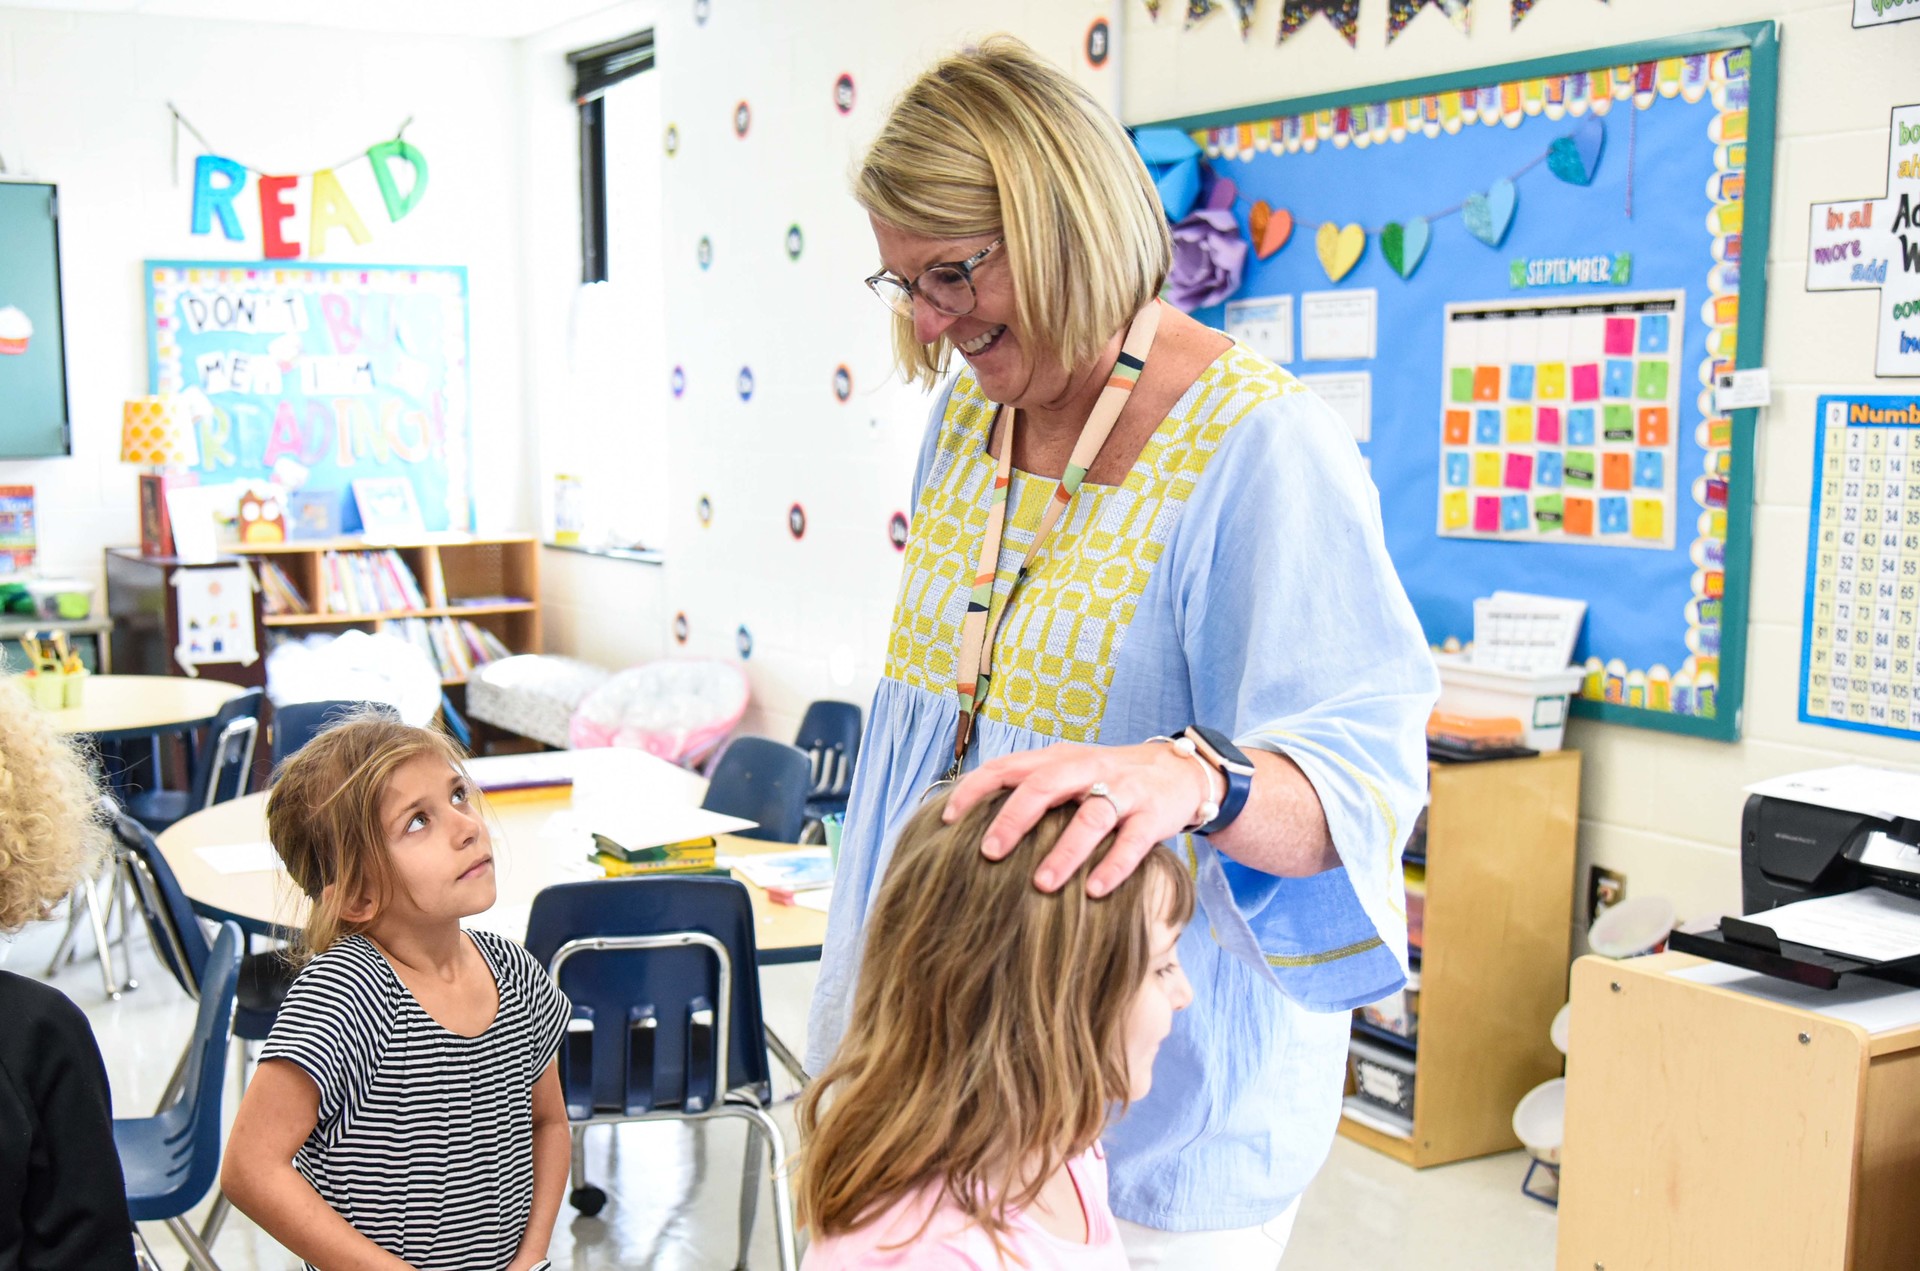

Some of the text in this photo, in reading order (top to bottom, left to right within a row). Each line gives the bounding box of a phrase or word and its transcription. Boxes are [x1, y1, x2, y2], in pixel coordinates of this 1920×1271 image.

[191, 140, 429, 259] READ
[1848, 202, 1873, 230] all
[1814, 239, 1862, 265] more
[1527, 256, 1610, 286] SEPTEMBER
[1850, 258, 1888, 283] add
[188, 294, 298, 330] DON'T
[1849, 457, 1860, 472] 12
[1870, 458, 1881, 473] 13
[1890, 459, 1901, 473] 14
[1911, 460, 1920, 475] 15
[1846, 482, 1859, 497] 22
[1866, 483, 1879, 498] 23
[1888, 484, 1900, 499] 24
[1909, 485, 1920, 500] 25
[1845, 507, 1857, 522] 32
[1864, 508, 1877, 523] 33
[1885, 509, 1899, 524] 34
[1907, 510, 1920, 525] 35
[1843, 531, 1855, 546] 42
[1863, 532, 1876, 547] 43
[1884, 534, 1897, 548] 44
[1905, 535, 1919, 550] 45
[1841, 555, 1853, 570] 52
[1861, 556, 1874, 572] 53
[1881, 558, 1895, 573] 54
[1903, 560, 1917, 575] 55
[1879, 583, 1893, 598] 64
[1900, 585, 1914, 600] 65
[1838, 604, 1849, 619] 72
[1858, 605, 1870, 620] 73
[1879, 608, 1890, 622] 74
[1900, 609, 1912, 625] 75
[1875, 632, 1889, 647] 84
[1896, 634, 1910, 649] 85
[1874, 656, 1887, 670] 94
[1894, 658, 1908, 674] 95
[1832, 676, 1848, 691] 102
[1851, 678, 1867, 693] 103
[1871, 681, 1888, 695] 104
[1891, 683, 1909, 699] 105
[1851, 703, 1864, 717] 113
[1870, 705, 1885, 719] 114
[1891, 707, 1906, 723] 115
